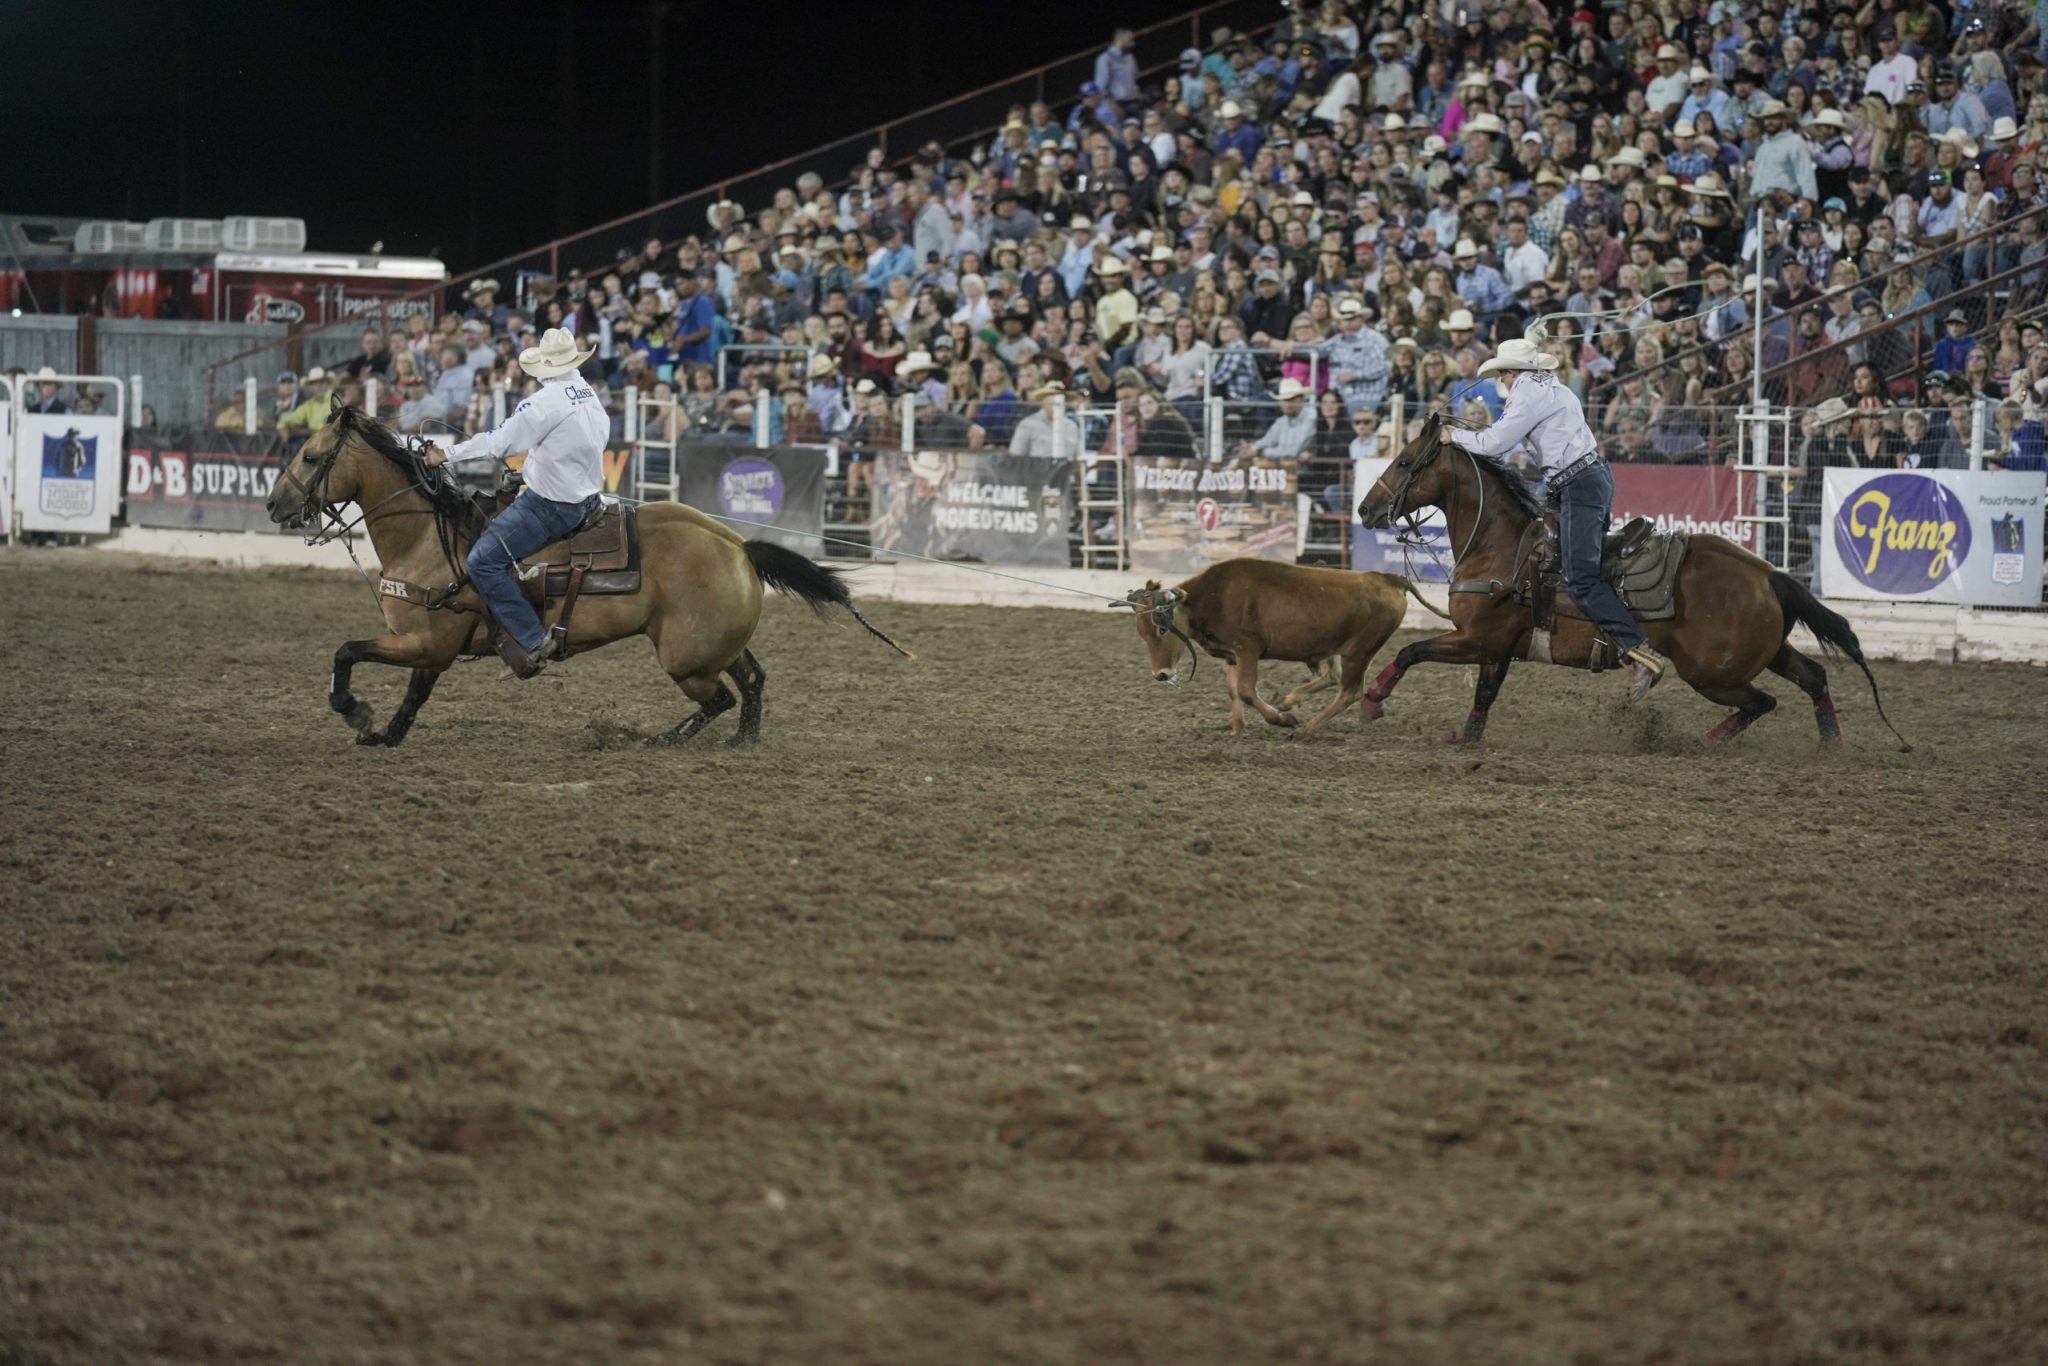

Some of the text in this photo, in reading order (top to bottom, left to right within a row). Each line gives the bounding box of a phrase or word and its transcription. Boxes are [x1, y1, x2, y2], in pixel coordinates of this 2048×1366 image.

[127, 454, 280, 497] D&B SUPPLY
[947, 482, 1029, 507] WELCOME
[1979, 495, 2001, 506] Proud
[935, 507, 992, 530] RODEO
[993, 510, 1039, 533] FANS
[1655, 513, 1753, 542] Alphonsus
[1850, 490, 1957, 579] Franz
